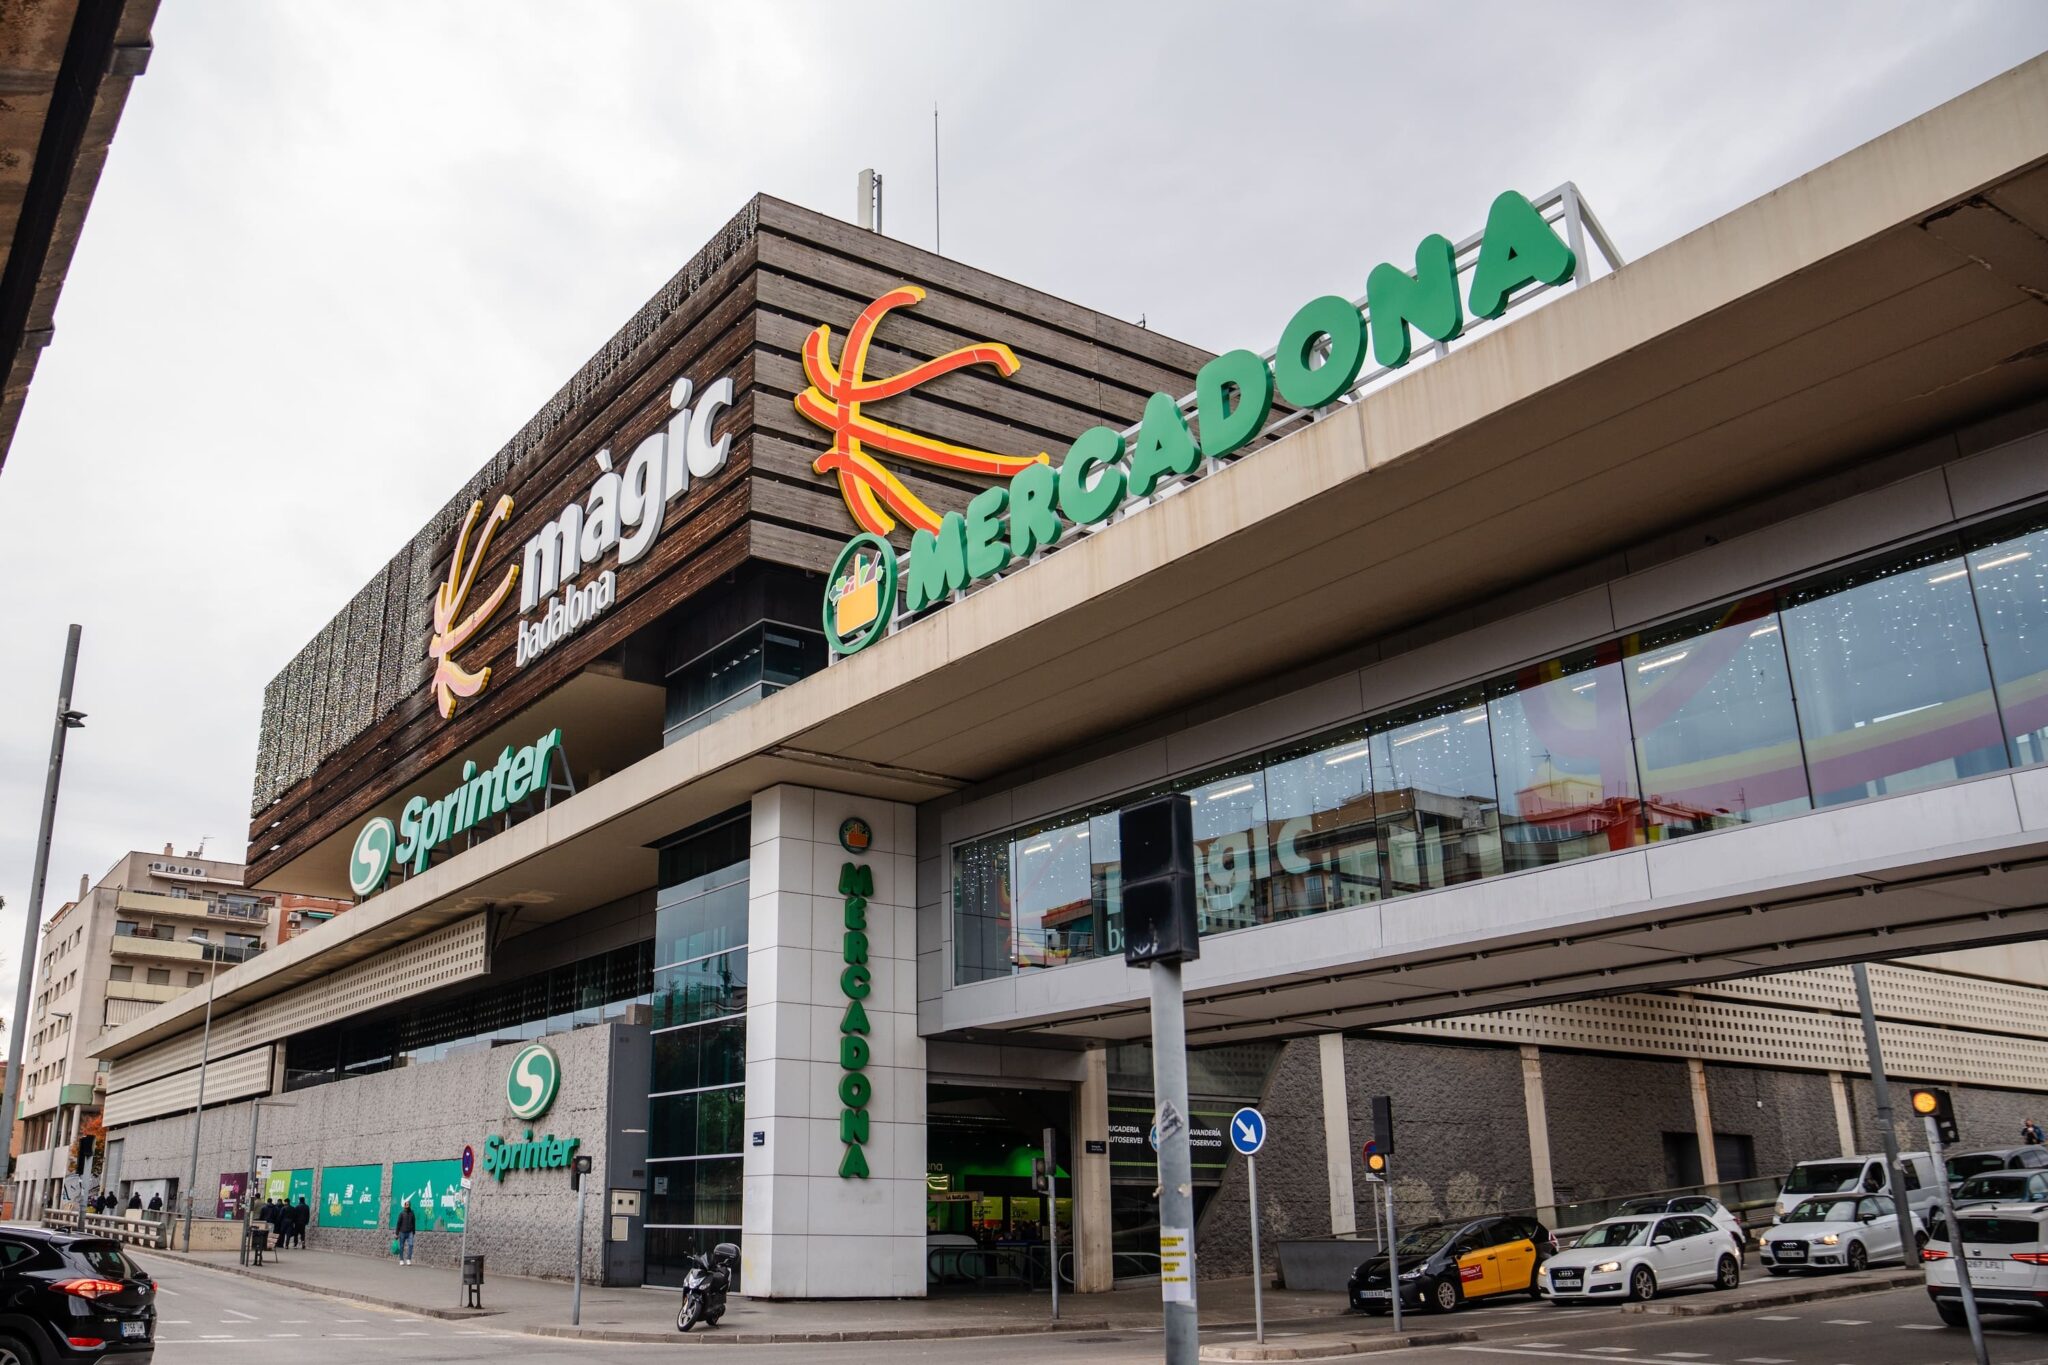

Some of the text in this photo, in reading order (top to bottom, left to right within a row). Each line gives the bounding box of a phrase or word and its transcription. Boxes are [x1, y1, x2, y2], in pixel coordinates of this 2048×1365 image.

[907, 190, 1576, 612] MERCADONA
[519, 376, 734, 614] màgic
[516, 570, 616, 668] badalona
[396, 728, 562, 875] Sprinter
[839, 862, 874, 1179] MERCADONA
[483, 1129, 580, 1182] Sprinter
[1188, 1128, 1221, 1138] AVANDERÍA
